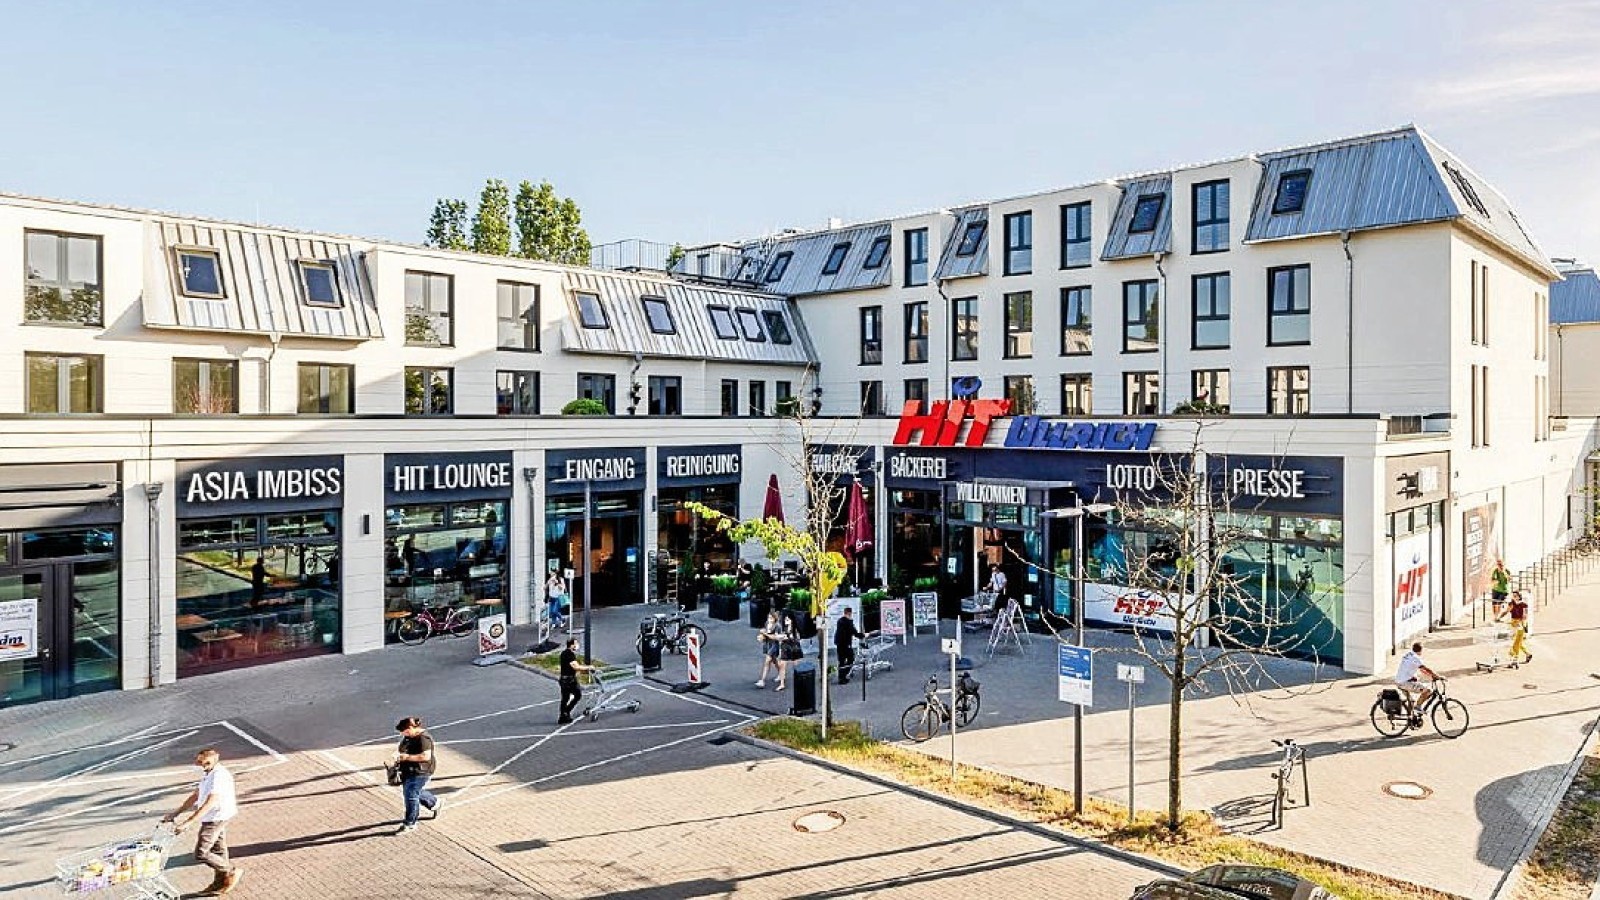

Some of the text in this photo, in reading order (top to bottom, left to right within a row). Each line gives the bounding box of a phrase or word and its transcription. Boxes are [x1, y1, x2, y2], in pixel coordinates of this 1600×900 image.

[894, 398, 1157, 450] HIT ULLRICH
[394, 463, 510, 492] HIT LOUNGE
[565, 458, 635, 480] EINGANG
[666, 454, 739, 477] REINIGUNG
[891, 453, 947, 478] BÄCKEREI
[1106, 464, 1155, 490] LOTTO
[187, 468, 341, 502] ASIA IMBISS
[956, 482, 1027, 505] WILLKOMMEN
[1233, 468, 1305, 498] PRESSE
[1395, 564, 1428, 609] HIT
[1113, 597, 1164, 616] HIT
